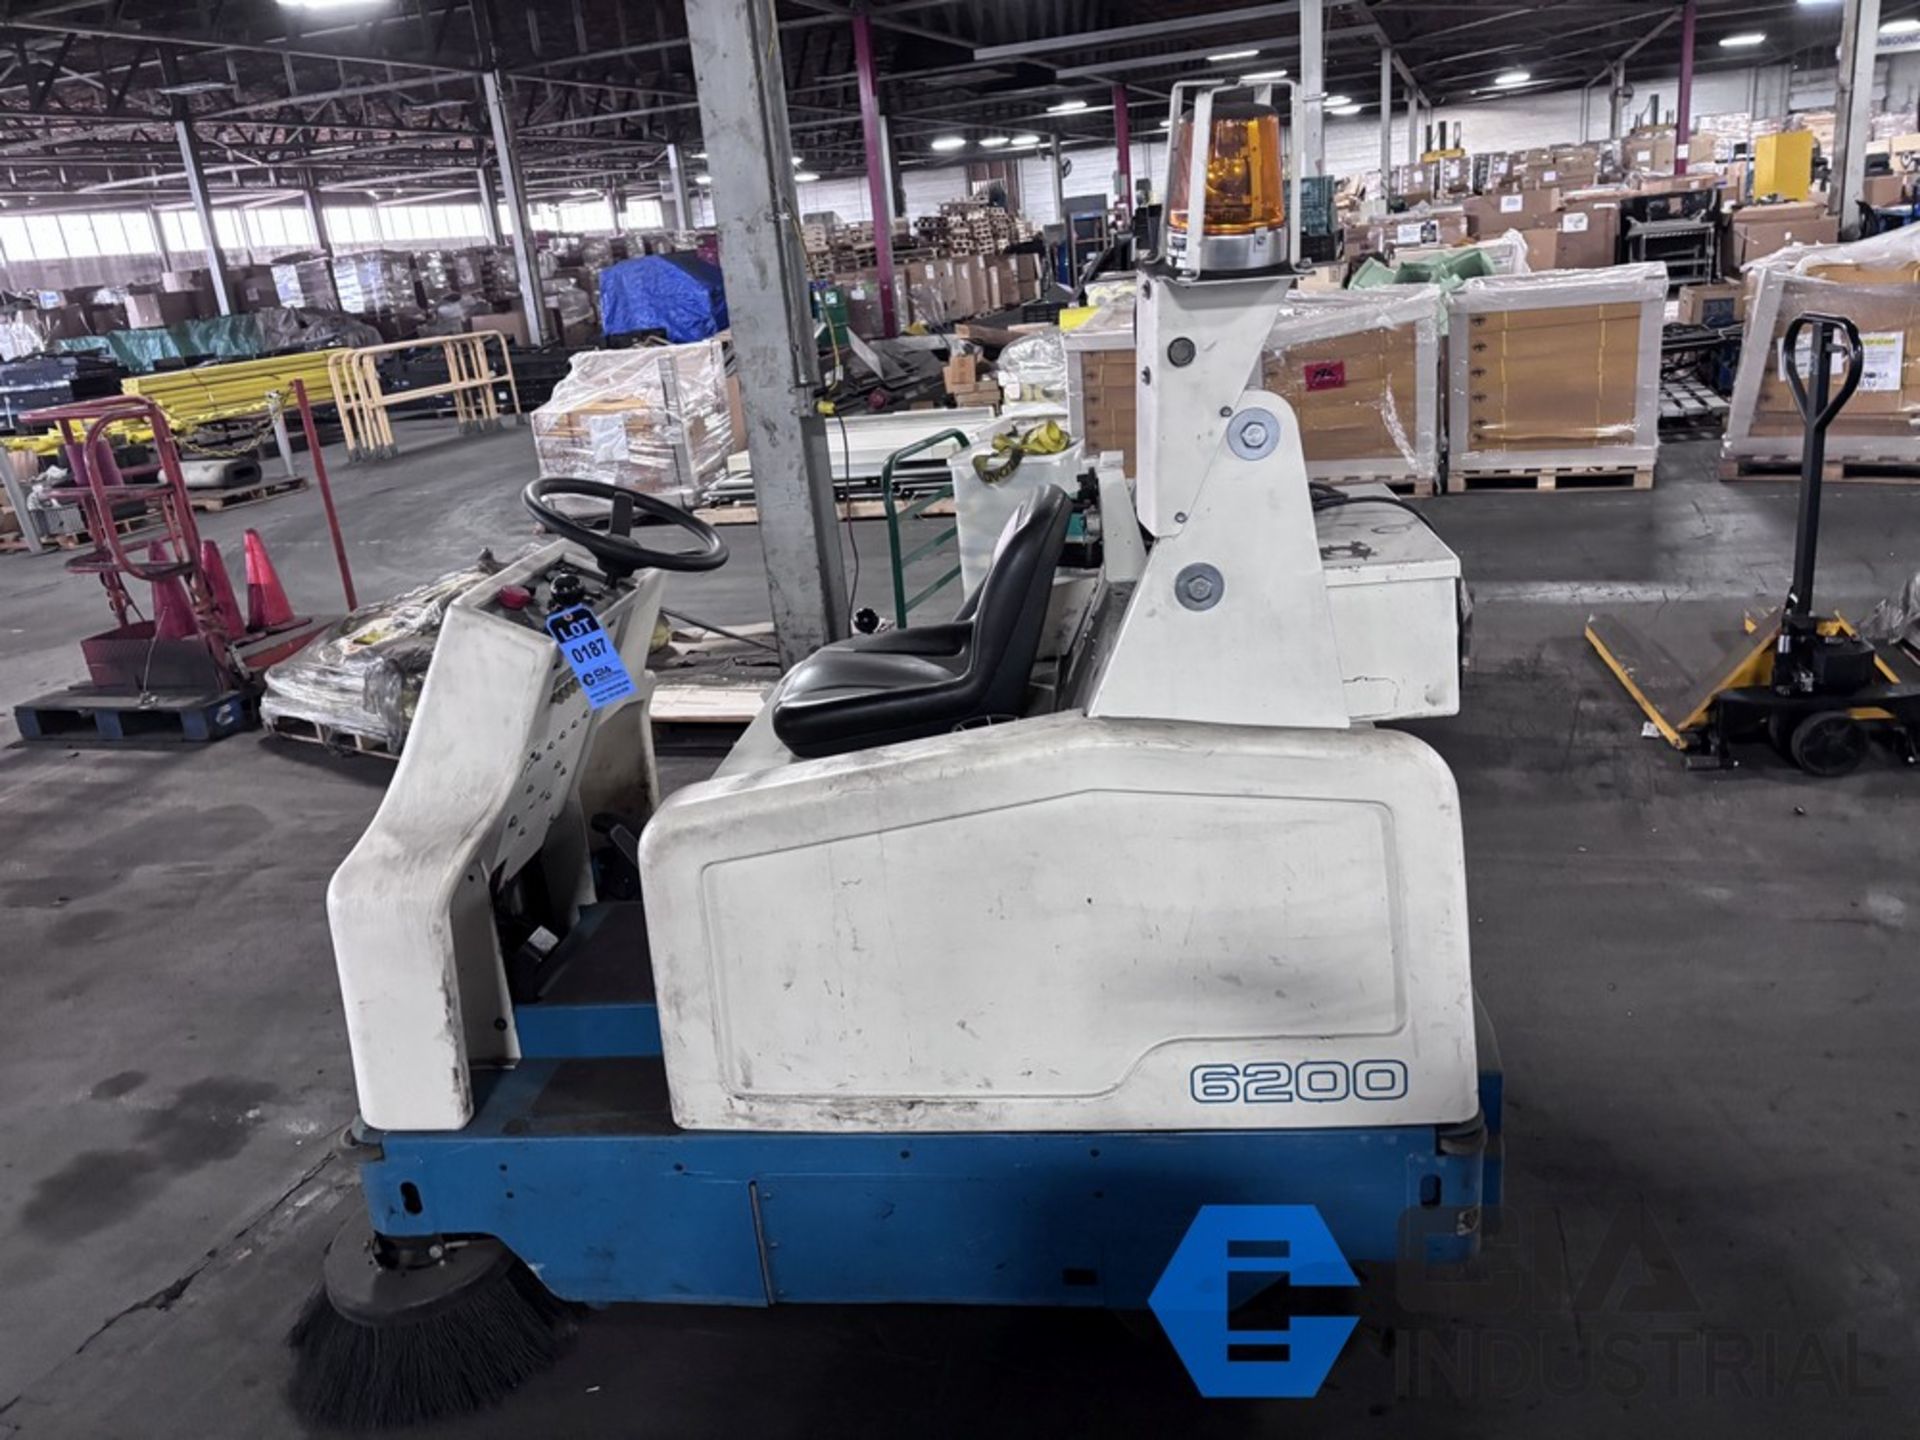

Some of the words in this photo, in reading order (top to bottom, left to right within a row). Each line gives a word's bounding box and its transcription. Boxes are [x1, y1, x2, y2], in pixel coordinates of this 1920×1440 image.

[558, 618, 592, 641] LOT
[571, 637, 607, 663] 0187
[1190, 1059, 1408, 1103] 6200
